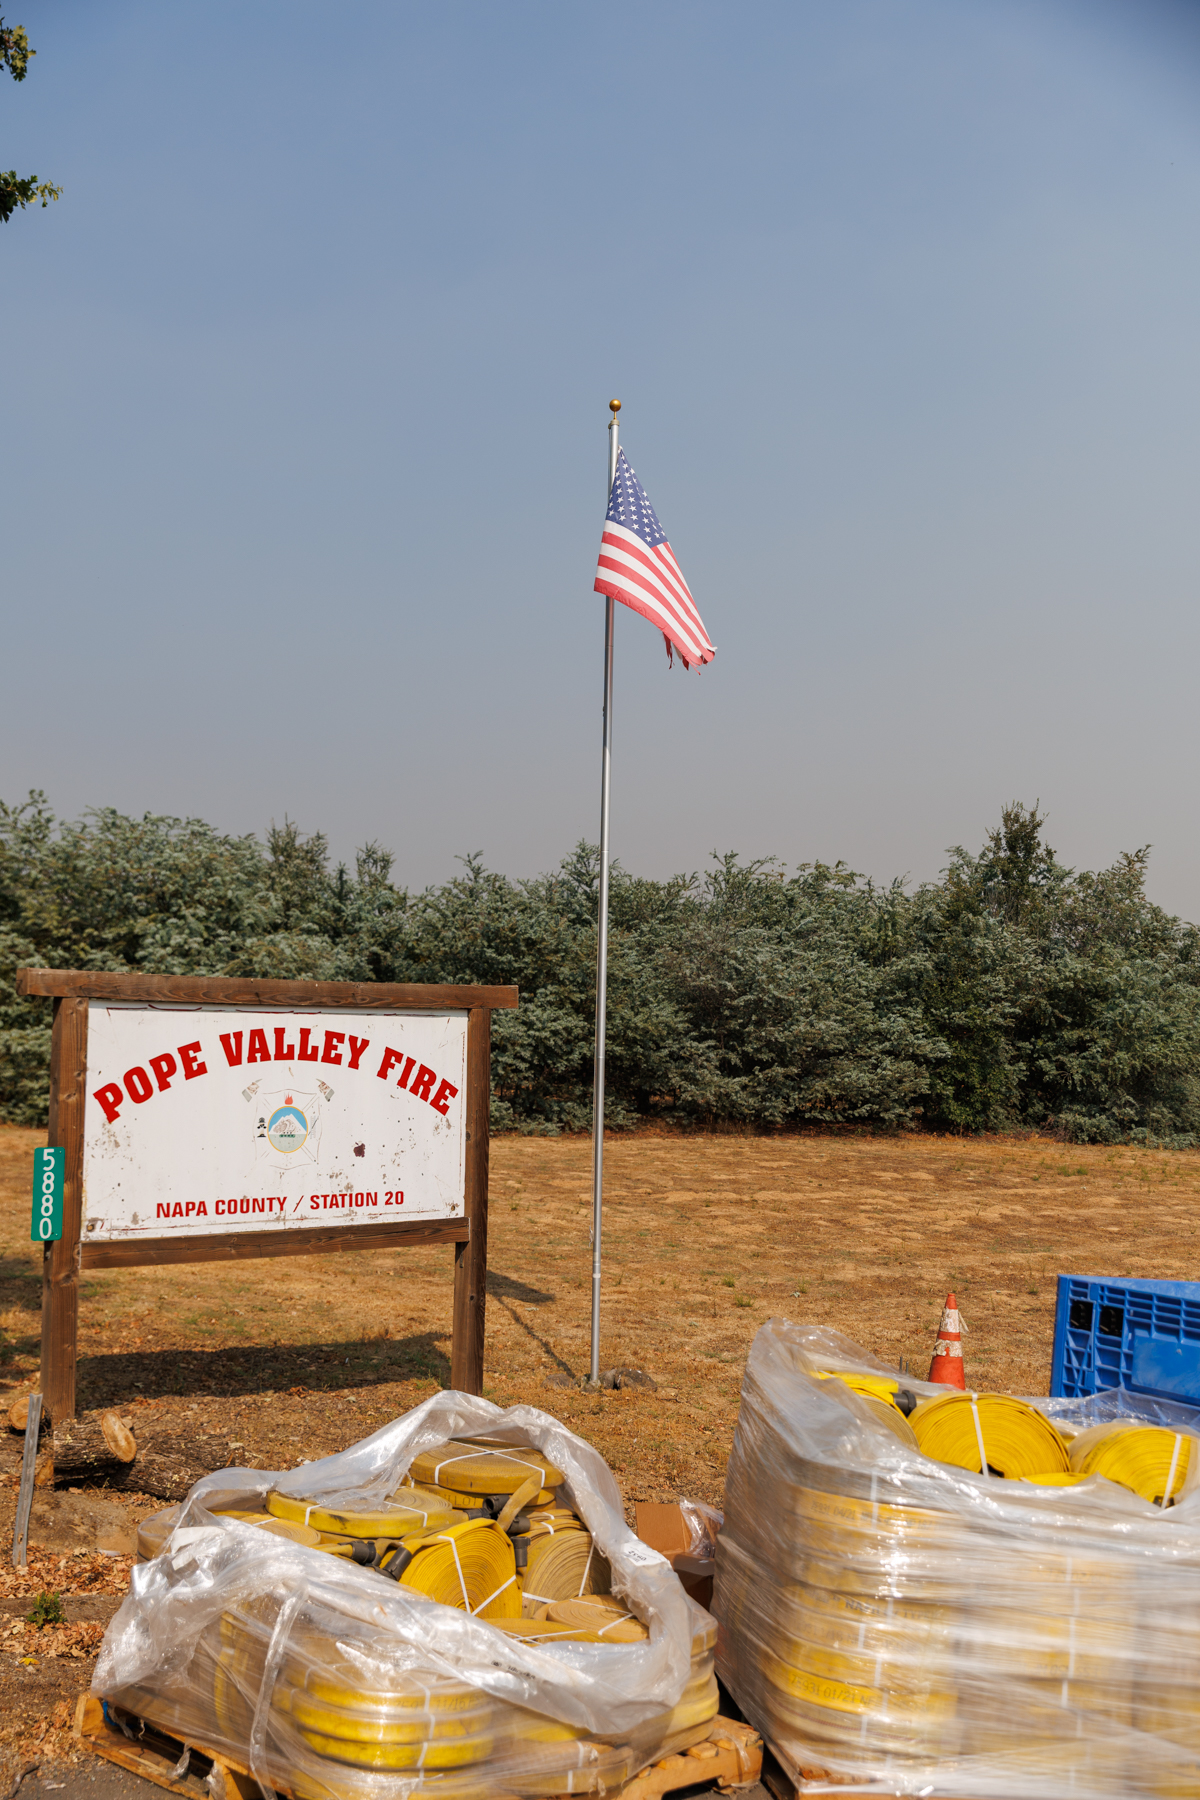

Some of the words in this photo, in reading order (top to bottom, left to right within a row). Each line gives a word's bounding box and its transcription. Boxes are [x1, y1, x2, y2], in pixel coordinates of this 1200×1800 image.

[93, 1040, 209, 1123] POPE
[218, 1027, 371, 1071] VALLEY
[377, 1046, 459, 1117] FIRE
[39, 1148, 56, 1240] 5880
[156, 1200, 209, 1219] NAPA
[215, 1195, 287, 1216] COUNTY
[310, 1192, 378, 1210] STATION
[384, 1191, 405, 1206] 20
[791, 1673, 821, 1697] 7E931
[823, 1686, 856, 1704] 01/21
